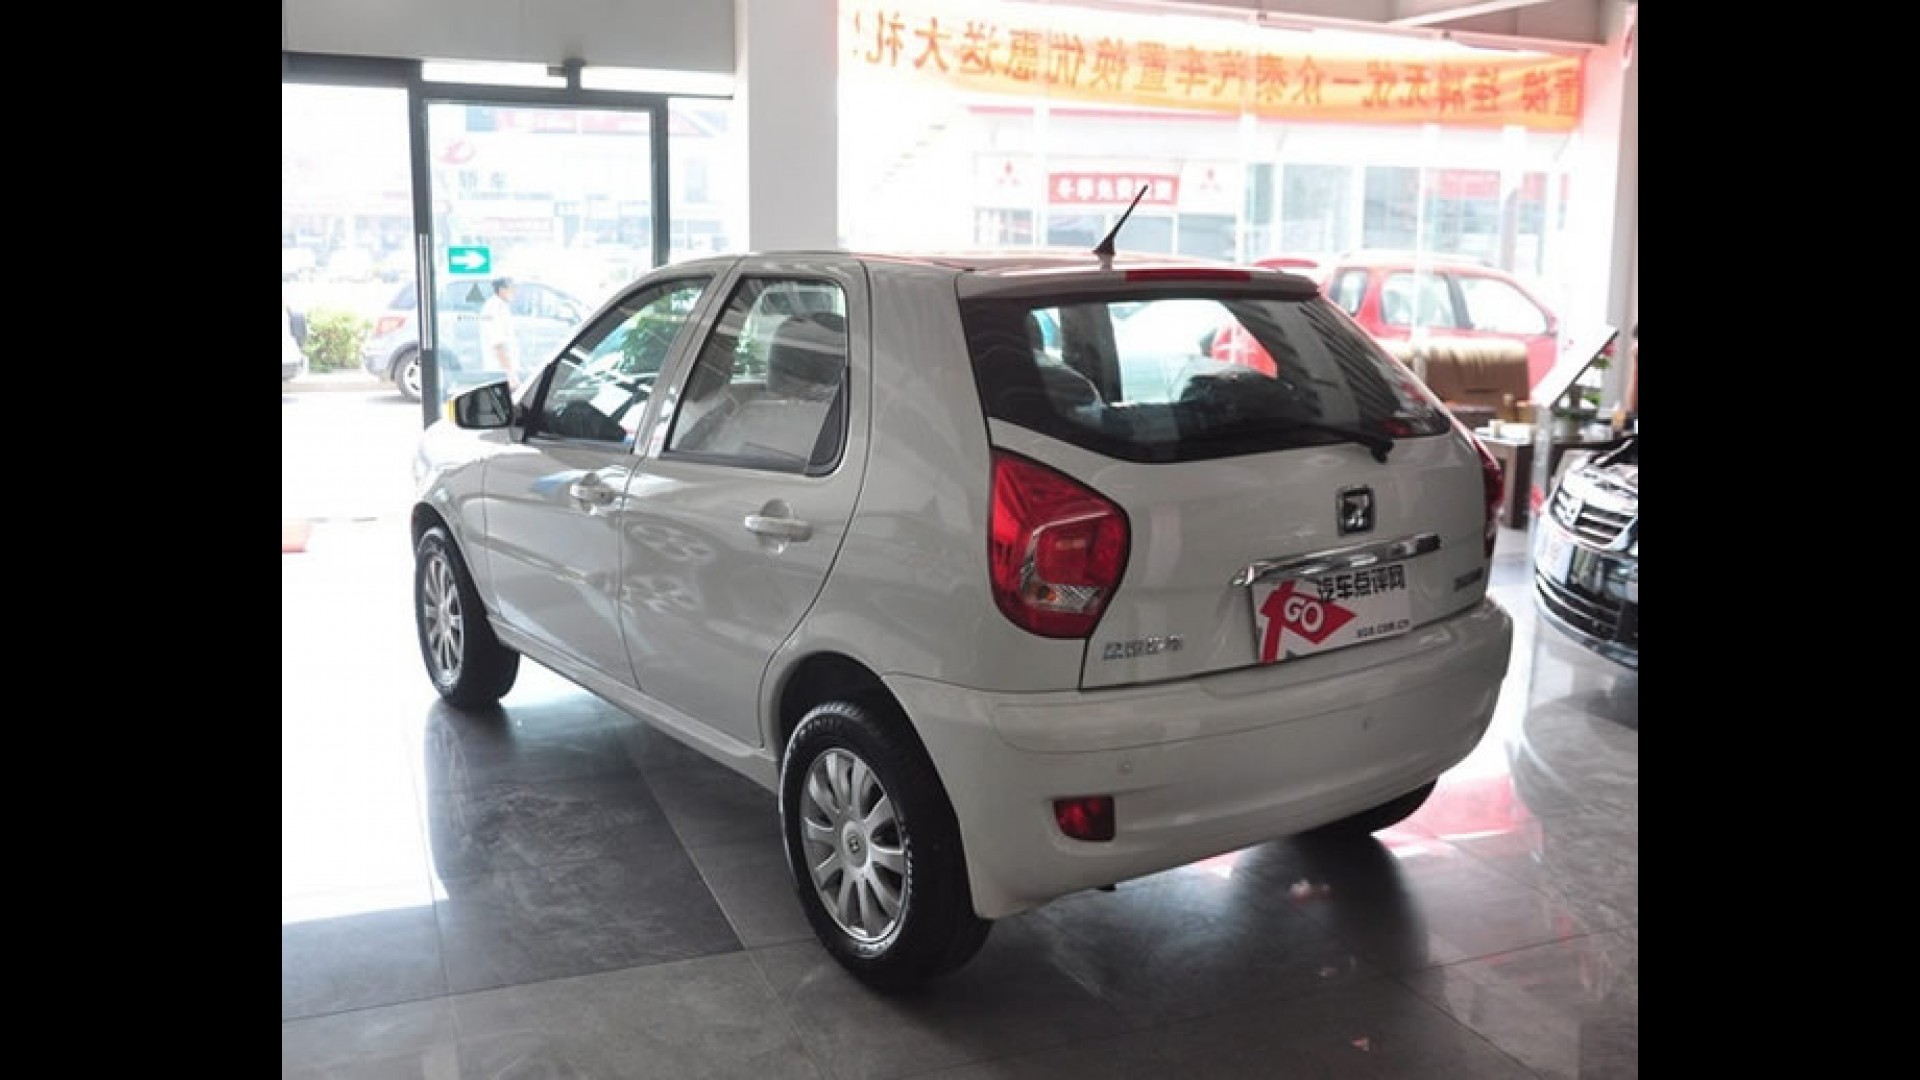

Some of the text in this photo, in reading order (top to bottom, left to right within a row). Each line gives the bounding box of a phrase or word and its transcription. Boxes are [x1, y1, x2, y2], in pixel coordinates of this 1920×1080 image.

[1316, 565, 1406, 602] 汽车点评网
